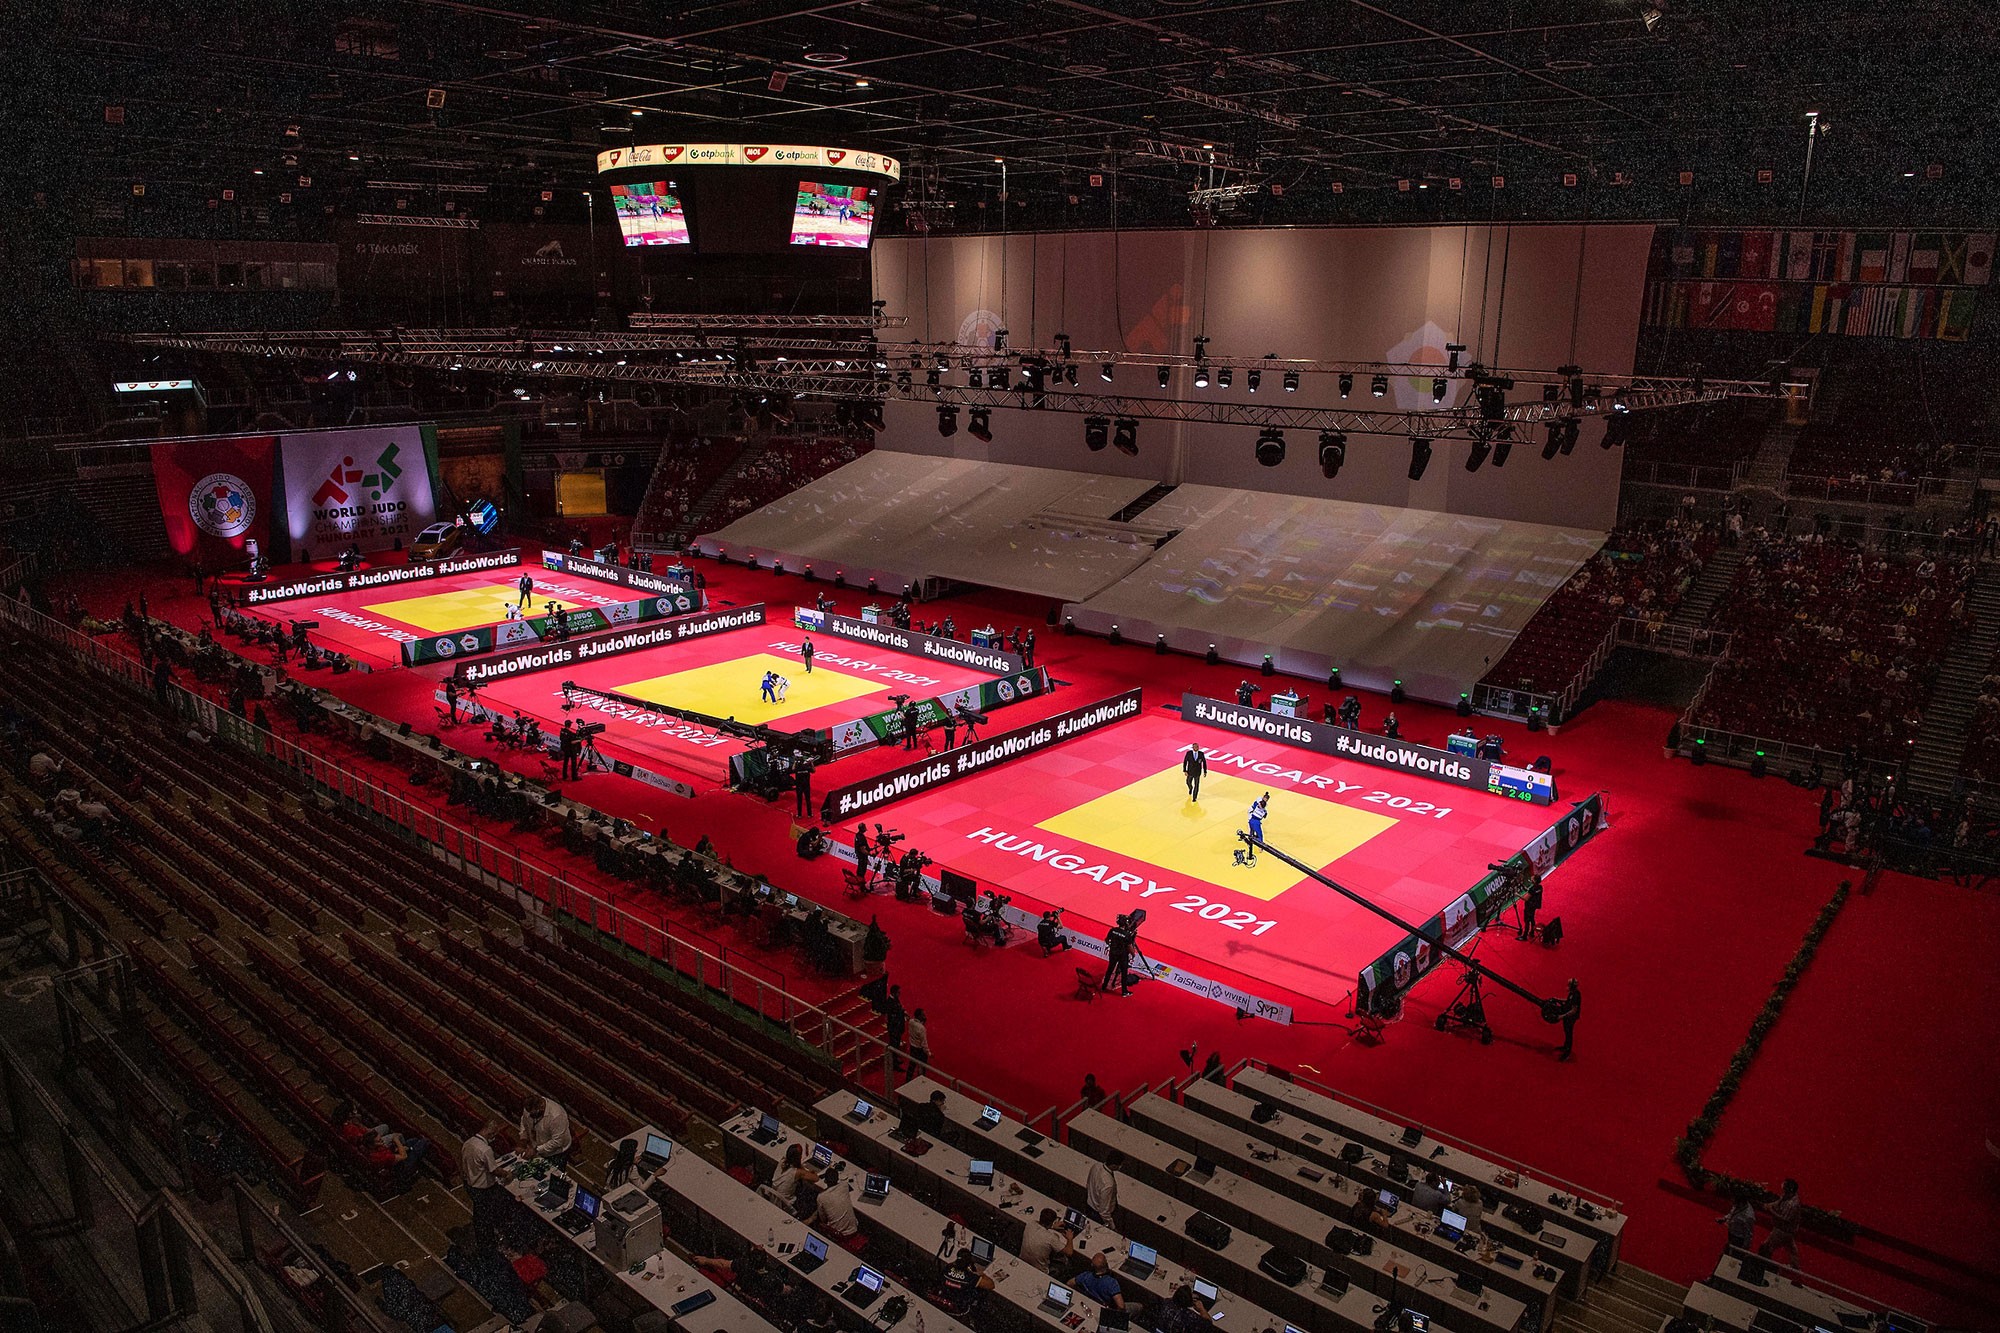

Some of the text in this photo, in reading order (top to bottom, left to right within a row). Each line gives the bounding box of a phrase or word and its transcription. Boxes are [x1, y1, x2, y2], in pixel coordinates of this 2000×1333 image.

[701, 149, 734, 159] otpbank
[786, 150, 818, 160] otpbank
[313, 501, 406, 520] WORLD JUDO
[315, 513, 408, 532] CHAMPIONSHIPS
[316, 524, 409, 543] HUNGARY 2021
[248, 553, 518, 602] #JudoWorlds #JudoWorlds #JudoWorlds
[568, 560, 684, 595] #JudoWorlds #JudoWorlds
[312, 607, 394, 632] HUNGARY
[574, 611, 592, 620] JUDO
[466, 610, 761, 681] #JudoWorlds #JudoWorlds #JudoWorlds
[832, 620, 1010, 672] #JudoWorlds #JudoWorlds
[768, 641, 941, 687] HUGARY 2021
[661, 725, 729, 748] 2021
[1195, 703, 1471, 781] #JudoWorlds #JudoWorlds
[840, 698, 1138, 814] #JudoWorlds #JudoWorlds #JudoWorlds
[1361, 791, 1452, 819] 2021
[966, 827, 1278, 936] HUNGARY 2021
[1077, 939, 1102, 952] SUZUKI
[1173, 973, 1208, 992] TaiShan
[1224, 990, 1248, 1005] VIVIEN
[1255, 1000, 1279, 1019] SMP
